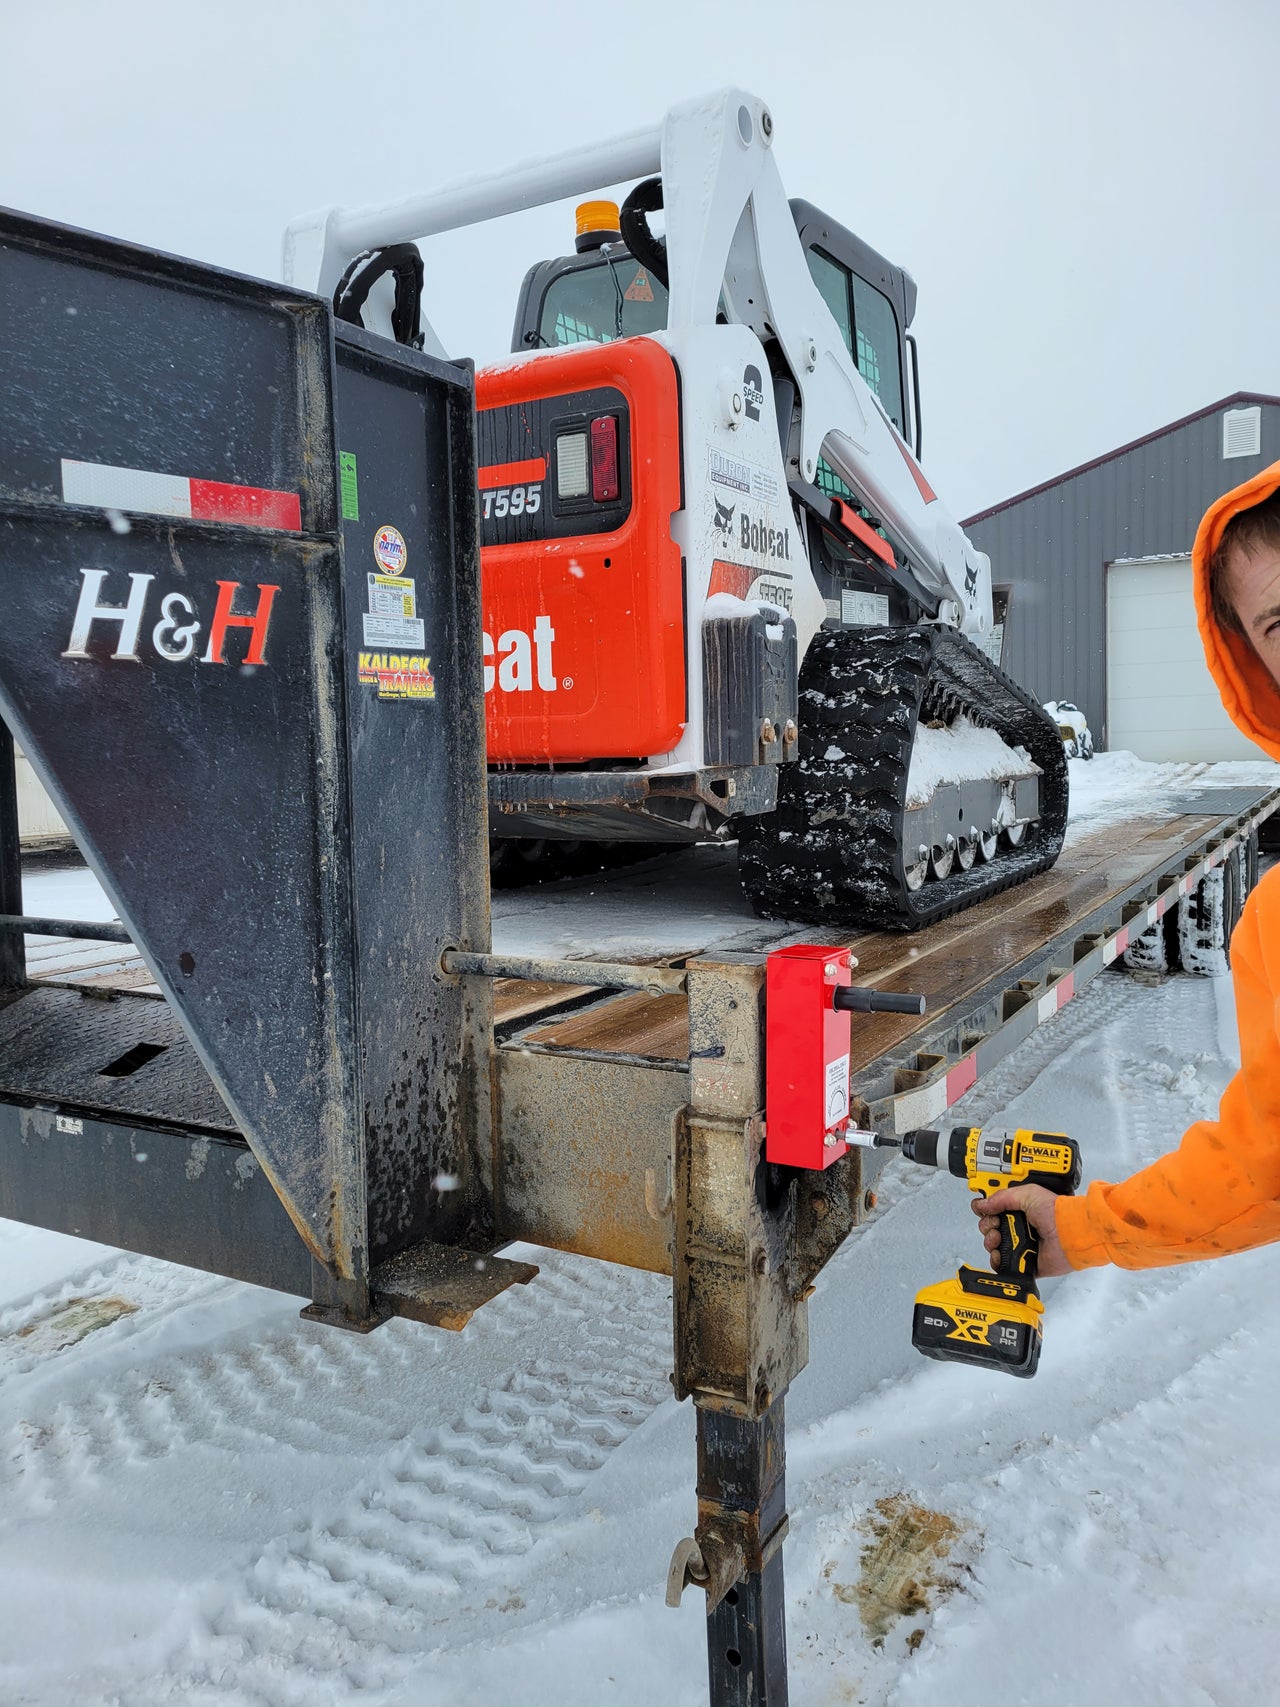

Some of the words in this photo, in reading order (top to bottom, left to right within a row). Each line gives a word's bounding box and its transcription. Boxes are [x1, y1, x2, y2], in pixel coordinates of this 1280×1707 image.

[743, 364, 763, 422] 2
[743, 386, 764, 404] SPEED
[710, 449, 751, 484] DURON
[711, 472, 739, 490] EQUIPMENT
[482, 485, 542, 519] T595
[740, 513, 789, 560] Bobcat
[61, 568, 281, 666] H&H
[358, 652, 431, 676] KALDECK
[378, 674, 435, 692] TRAILERS
[955, 1308, 987, 1322] DEWALT
[1000, 1327, 1018, 1340] 10
